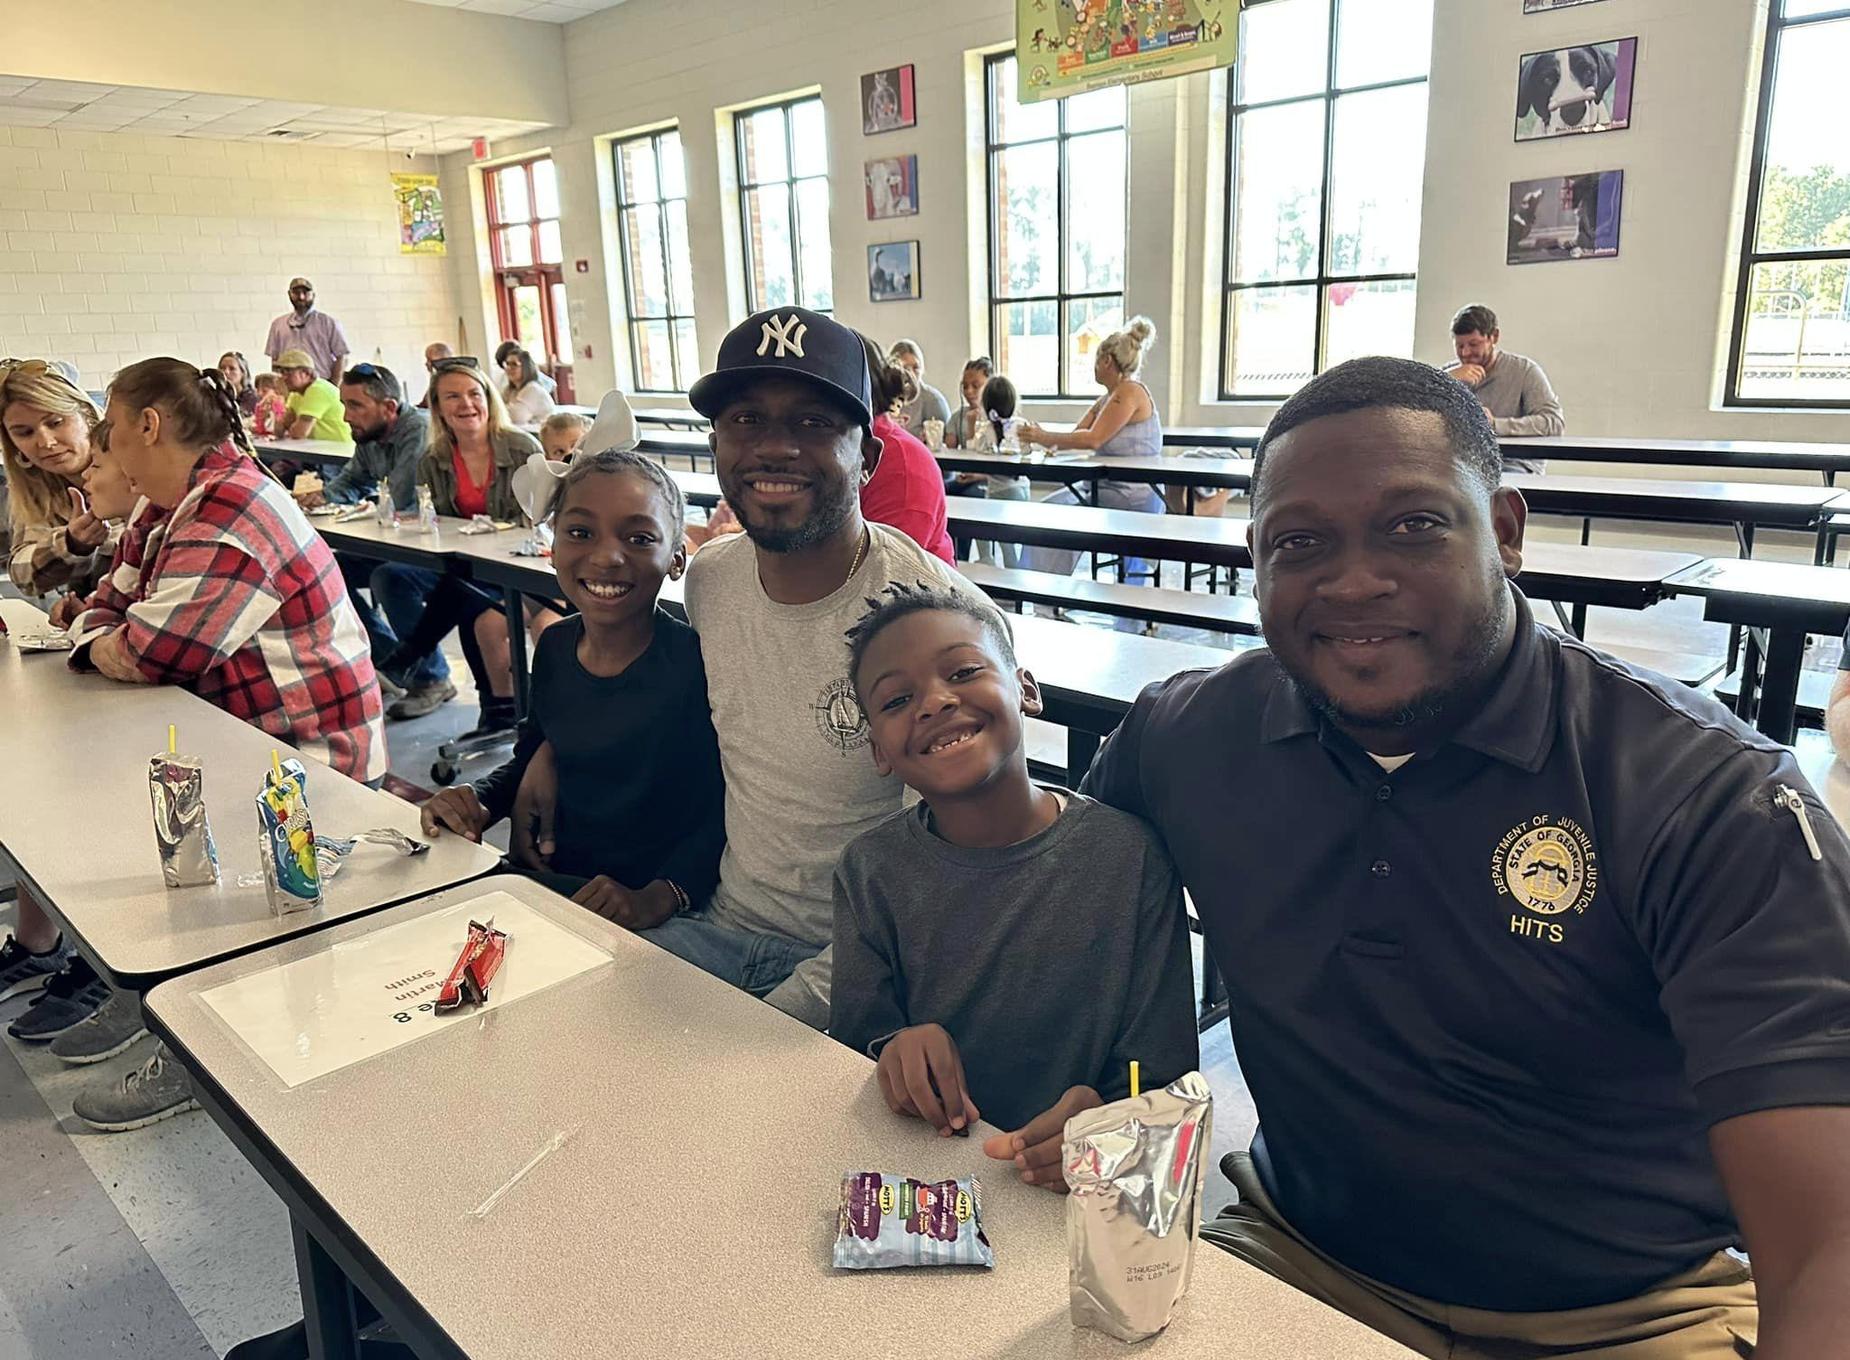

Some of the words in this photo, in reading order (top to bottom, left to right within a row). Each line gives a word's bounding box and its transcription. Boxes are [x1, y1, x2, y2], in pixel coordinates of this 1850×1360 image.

[756, 314, 807, 358] NY
[1532, 814, 1549, 826] OF
[1508, 838, 1533, 869] STATE
[1536, 830, 1552, 841] OF
[1556, 833, 1582, 883] GEORGIA
[1557, 816, 1596, 861] JUVENILE
[1491, 822, 1528, 895] DEPARTMENT
[1528, 895, 1556, 911] 1776
[1573, 864, 1598, 915] JUSTICE
[1510, 914, 1564, 942] HITS
[384, 969, 436, 990] Smith
[393, 1012, 413, 1023] 8
